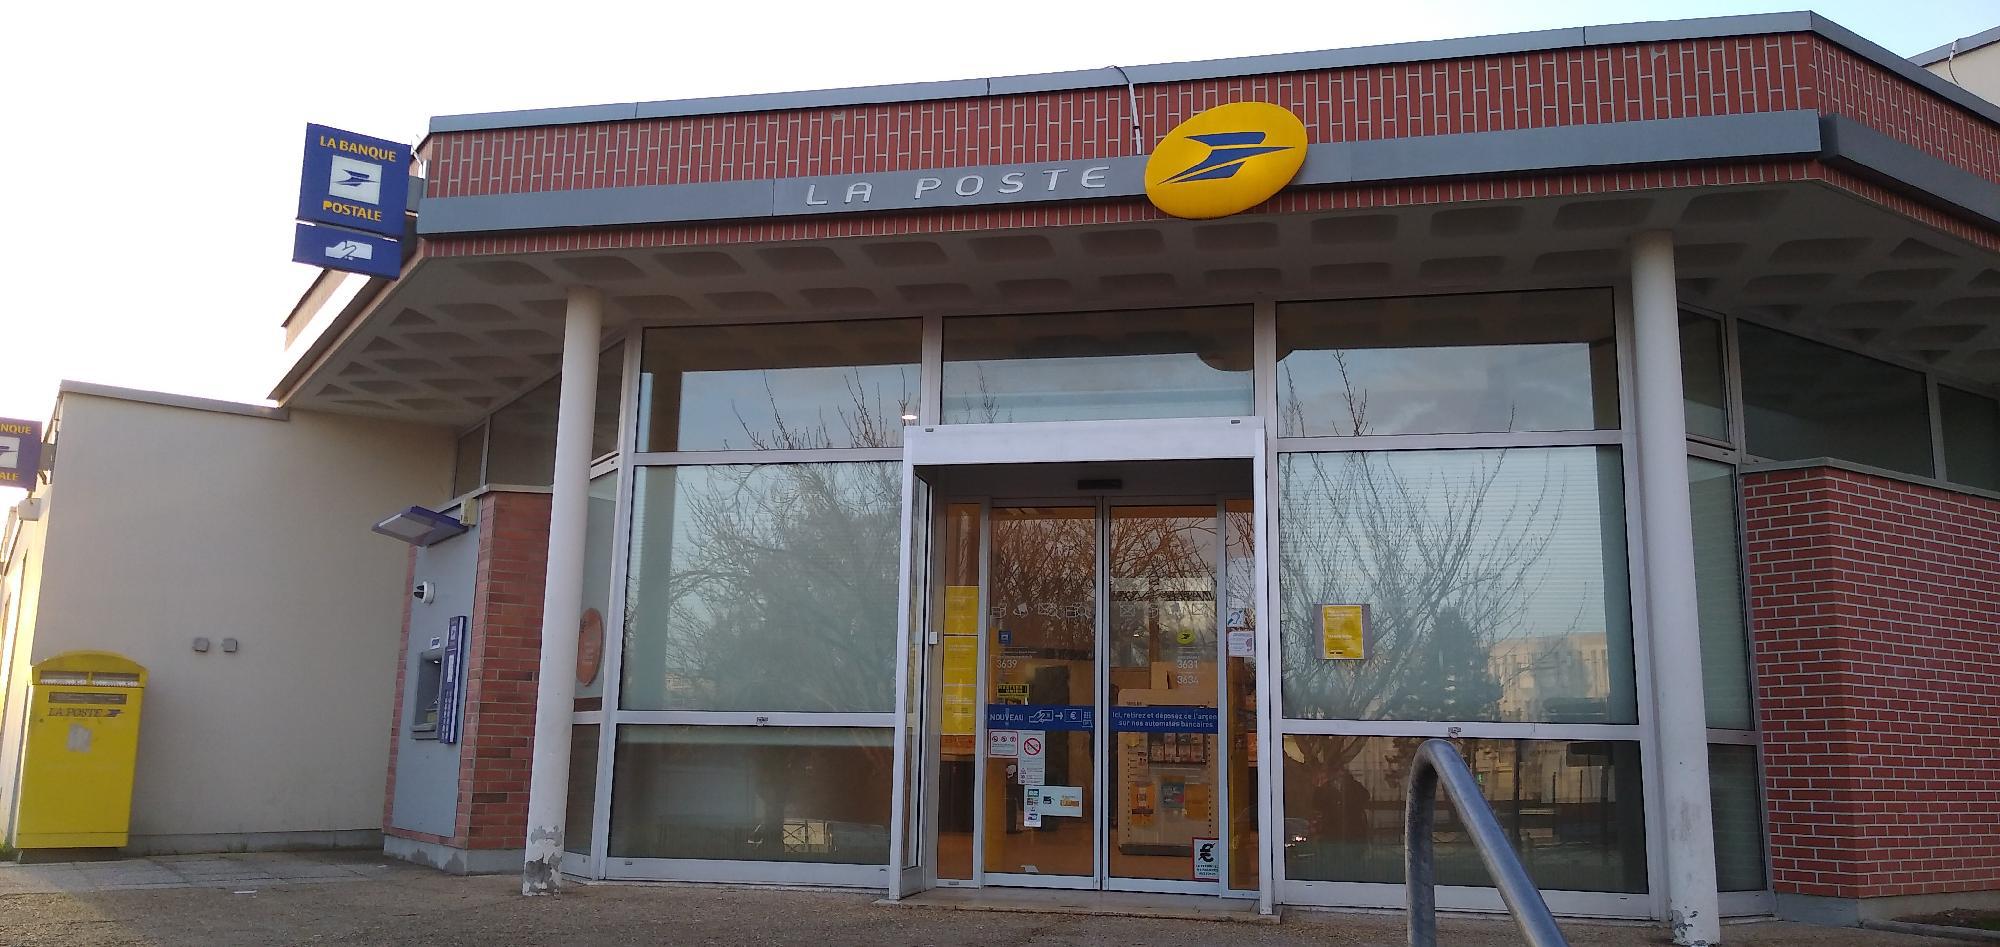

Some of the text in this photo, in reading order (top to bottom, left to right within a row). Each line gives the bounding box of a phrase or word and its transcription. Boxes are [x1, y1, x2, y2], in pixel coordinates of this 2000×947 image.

[320, 135, 397, 162] LA BANQUE
[805, 165, 1111, 206] LA POSTE
[322, 200, 382, 222] POSTALE
[0, 423, 32, 435] NQUE
[0, 471, 20, 481] ALE
[996, 659, 1017, 669] 3639
[1177, 659, 1198, 669] 3631
[66, 707, 103, 718] POSTE
[989, 713, 1024, 721] NOUVEAU
[1123, 711, 1145, 719] retirez
[1144, 720, 1180, 728] automates
[1180, 720, 1213, 728] bancaires
